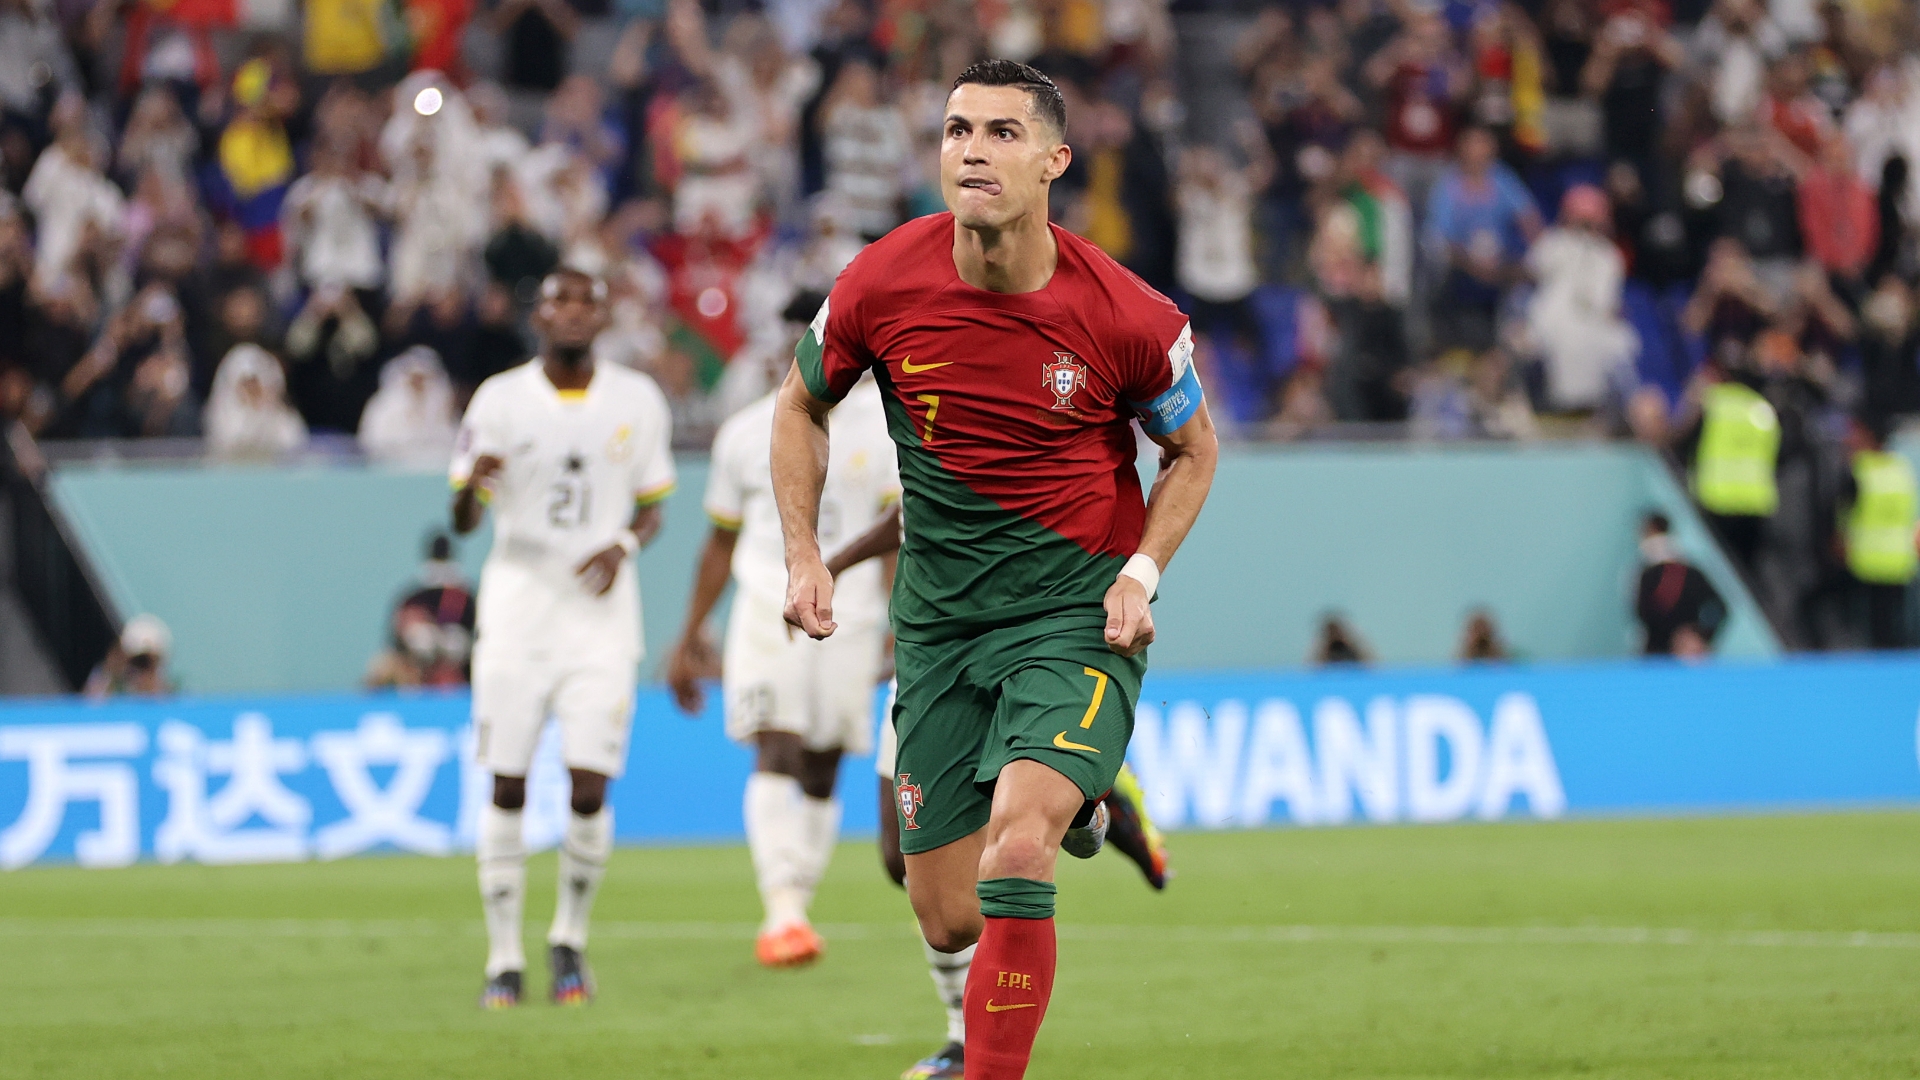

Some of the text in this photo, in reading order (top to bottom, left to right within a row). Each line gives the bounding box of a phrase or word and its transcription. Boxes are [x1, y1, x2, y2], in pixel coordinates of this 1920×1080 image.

[917, 393, 939, 442] 7
[1159, 394, 1186, 417] UNITES
[548, 482, 592, 528] 21
[1079, 666, 1108, 730] 7
[1133, 692, 1566, 826] WANDA
